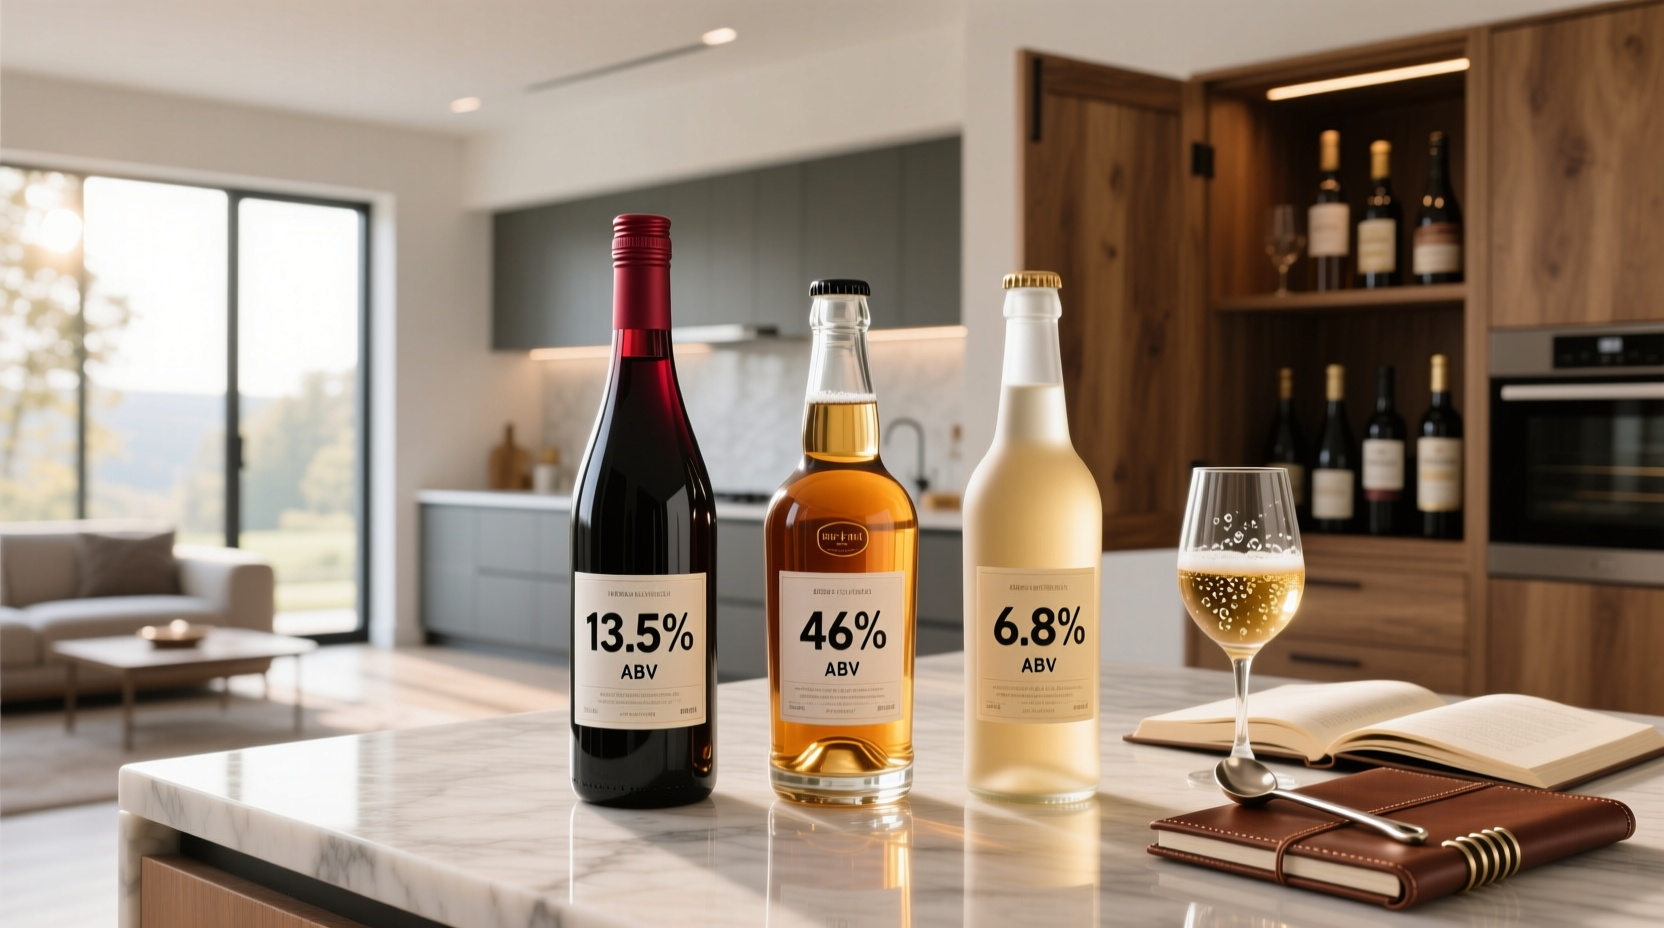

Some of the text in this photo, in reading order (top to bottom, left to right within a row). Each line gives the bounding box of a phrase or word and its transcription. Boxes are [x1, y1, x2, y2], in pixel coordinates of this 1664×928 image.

[586, 611, 694, 653] 13.5%
[799, 610, 887, 651] 46%
[993, 606, 1086, 647] 6.8%
[620, 663, 658, 680] ABV
[824, 661, 860, 677] ABV
[1021, 657, 1057, 673] ABV
